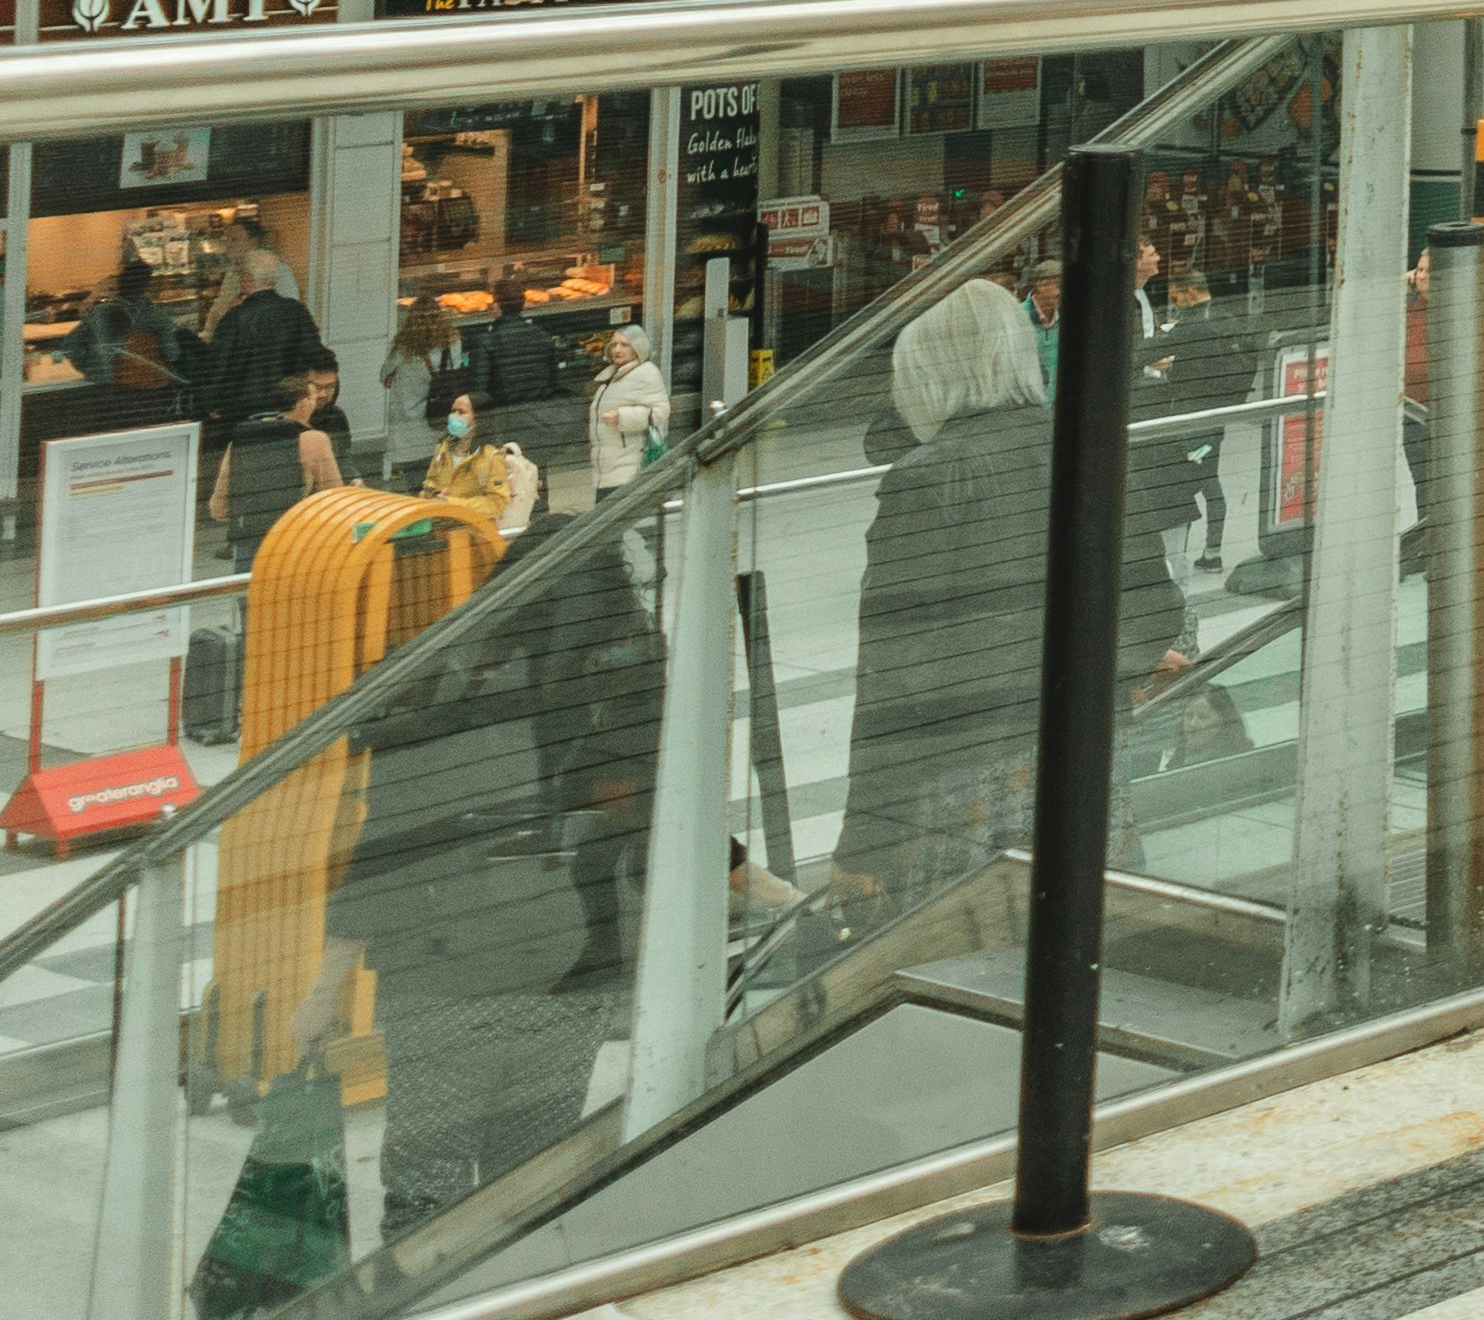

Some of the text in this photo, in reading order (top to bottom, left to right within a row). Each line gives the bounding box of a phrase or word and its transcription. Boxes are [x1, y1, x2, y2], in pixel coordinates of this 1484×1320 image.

[690, 86, 739, 121] POTS
[687, 130, 733, 155] Golden
[687, 159, 729, 184] with a
[70, 449, 172, 472] Service Alterations
[67, 775, 180, 813] greateranglia
